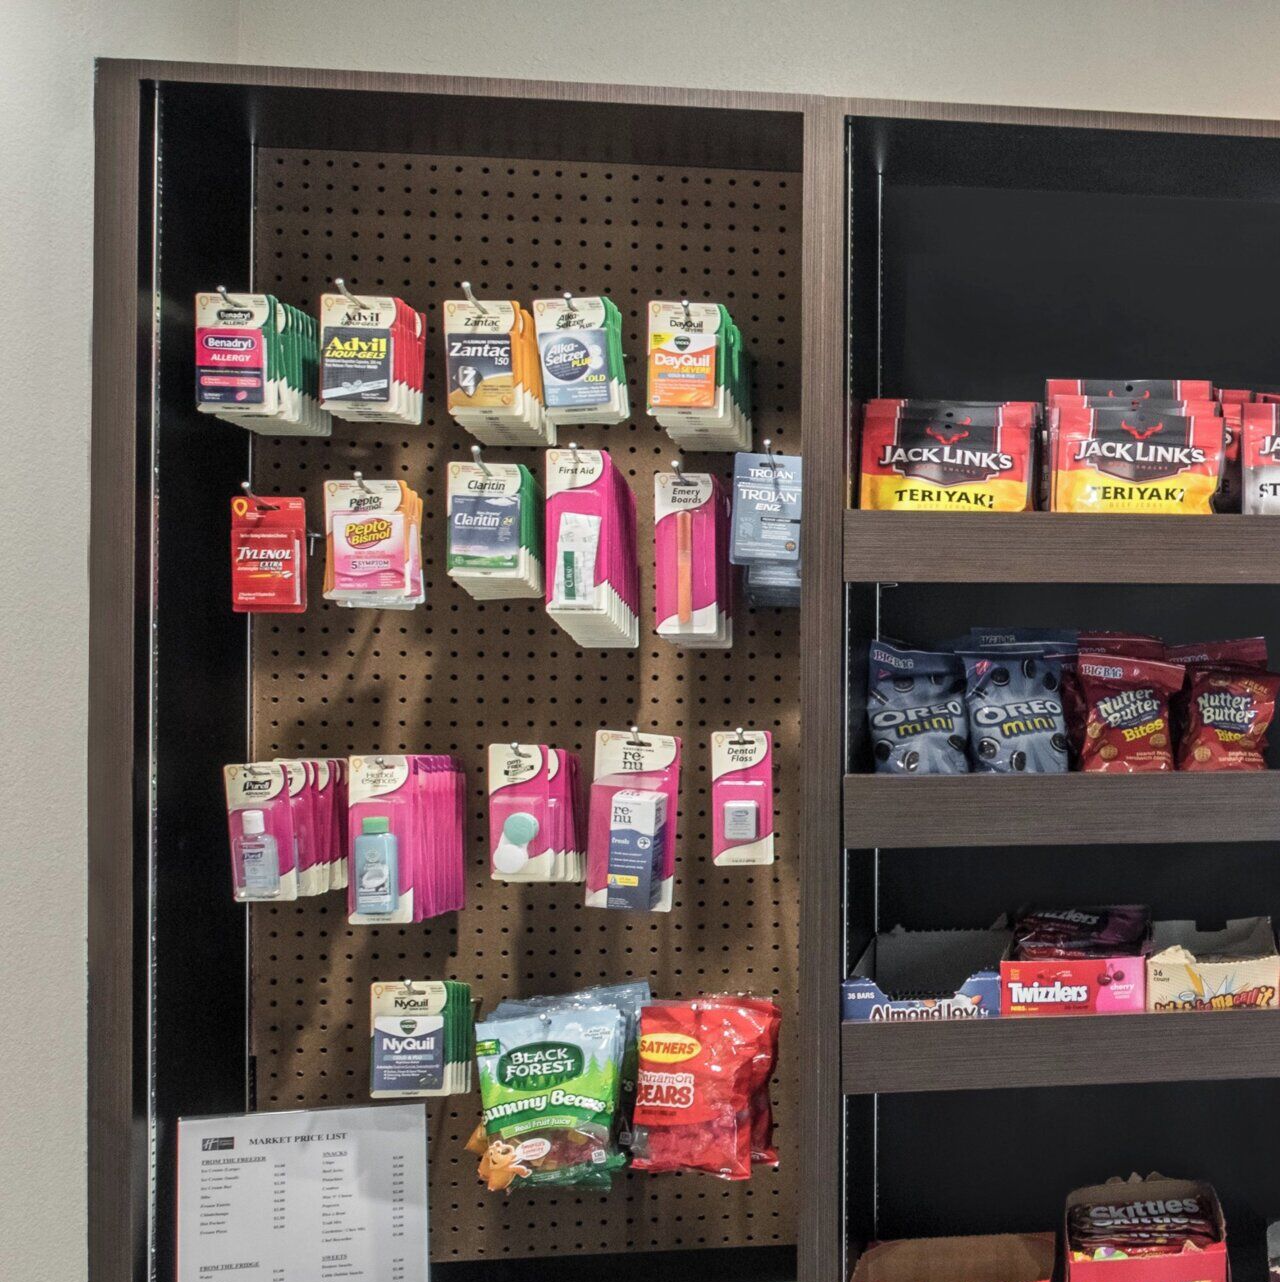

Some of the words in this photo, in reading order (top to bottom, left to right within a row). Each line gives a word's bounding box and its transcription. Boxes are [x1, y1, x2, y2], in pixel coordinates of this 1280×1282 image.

[463, 317, 500, 327] Zantac
[669, 319, 704, 330] DayQuil
[207, 336, 253, 350] Benadryl
[326, 337, 387, 351] Advil
[450, 342, 510, 359] Zantac
[548, 343, 579, 355] Alka-
[210, 354, 252, 362] ALLERGY
[324, 350, 386, 360] LIQUI-GELS
[494, 357, 509, 366] 150
[545, 350, 587, 367] Seltzer
[654, 354, 710, 370] DayQuil
[583, 375, 606, 383] COLD
[879, 445, 941, 466] JACK
[941, 445, 1013, 470] LINK'S
[1075, 441, 1134, 461] JACK
[1135, 442, 1206, 464] LINK'S
[558, 466, 578, 475] First
[580, 466, 595, 475] Aid
[749, 468, 794, 479] TROJAN
[467, 479, 506, 491] Claritin
[672, 487, 701, 497] Emery
[670, 495, 702, 504] Boards
[739, 488, 798, 503] TROJAN
[755, 502, 781, 512] ENZ
[454, 512, 500, 527] Claritin
[345, 519, 393, 538] Pepto-
[350, 530, 393, 547] Bismol
[237, 547, 292, 560] TYLENOL
[1097, 688, 1154, 718] Nutter
[1196, 692, 1251, 711] Nutter
[873, 701, 962, 727] OREO
[976, 701, 1062, 725] OREO
[1107, 698, 1161, 727] Butter
[1202, 706, 1256, 724] Butter
[898, 715, 954, 736] mini
[1002, 716, 1056, 736] mini
[1121, 718, 1165, 742] Bites
[727, 747, 757, 755] Dental
[730, 754, 753, 762] Floss
[1007, 981, 1088, 1004] Twizzlers
[1109, 983, 1135, 993] cherry
[394, 999, 429, 1009] NyQuil
[869, 1004, 944, 1020] Almond
[382, 1037, 435, 1053] NyQuil
[639, 1039, 697, 1056] SATHERS
[510, 1048, 568, 1065] BLACK
[505, 1058, 575, 1082] FOREST
[249, 1136, 291, 1146] MARKET
[294, 1134, 323, 1143] PRICE
[326, 1132, 347, 1141] LIST
[1089, 1199, 1200, 1218] Skittles
